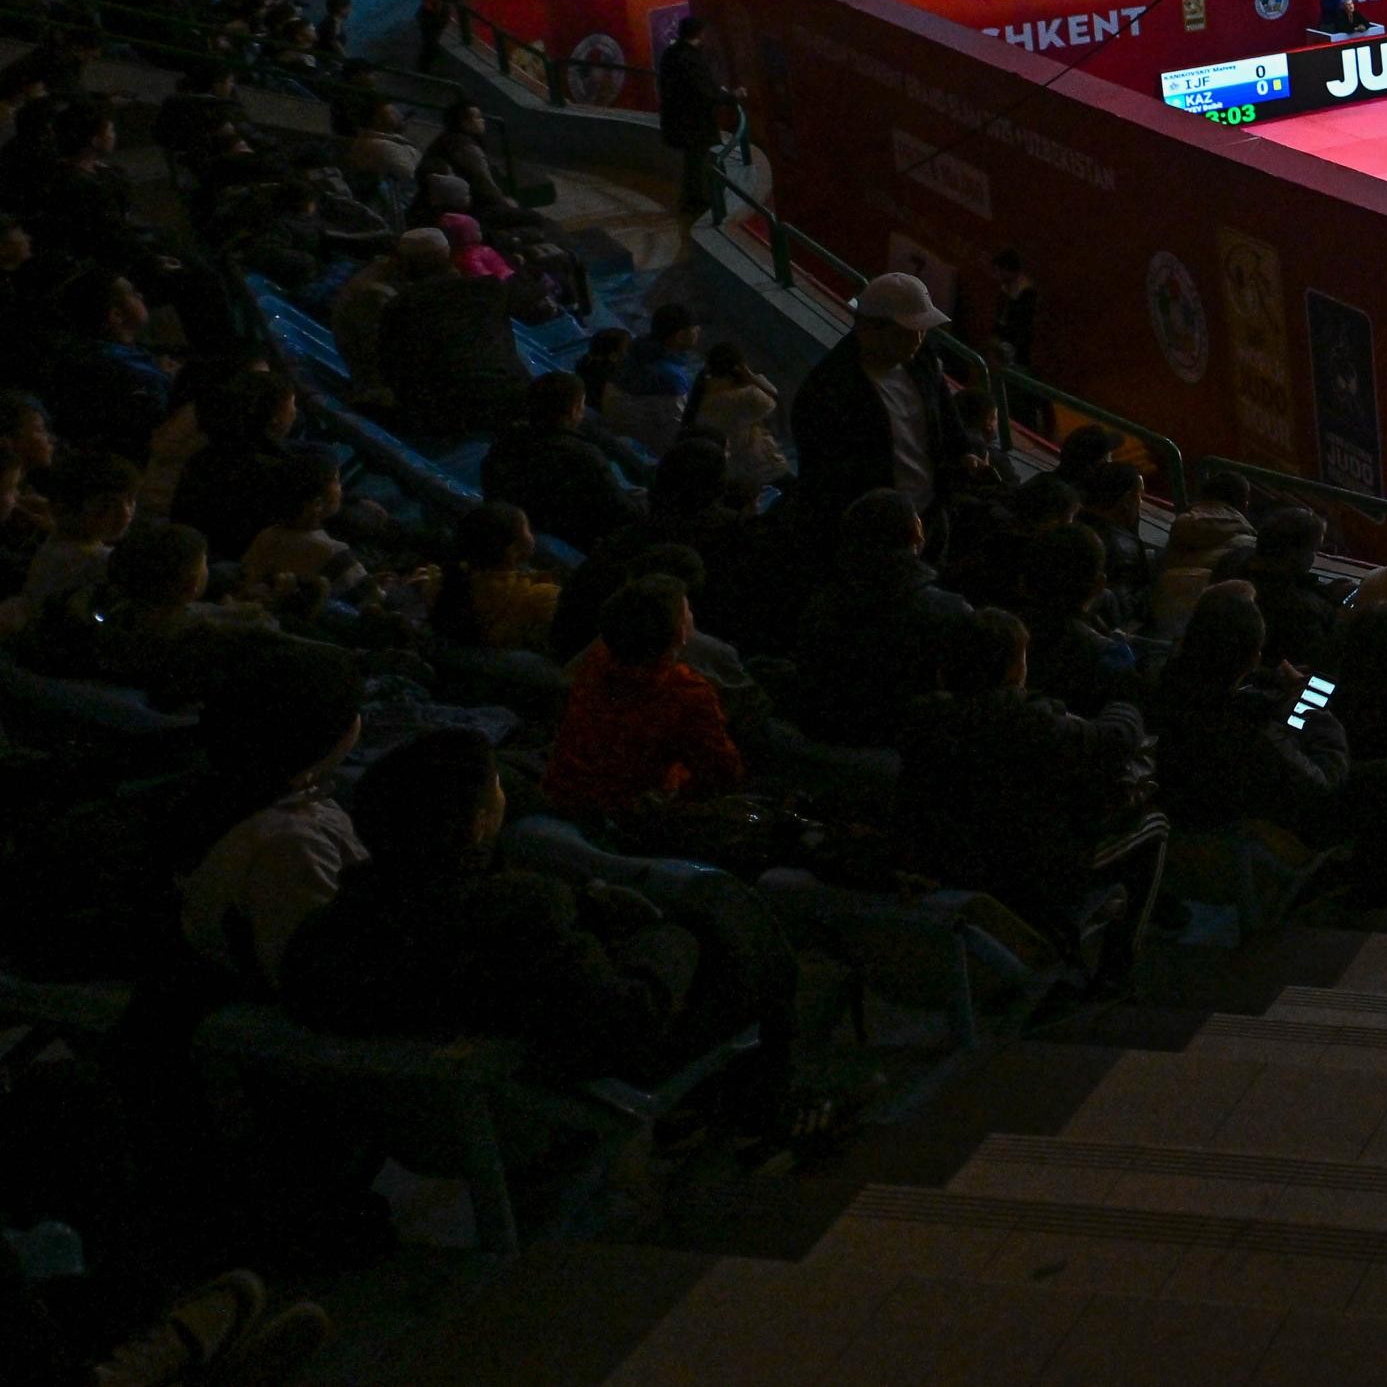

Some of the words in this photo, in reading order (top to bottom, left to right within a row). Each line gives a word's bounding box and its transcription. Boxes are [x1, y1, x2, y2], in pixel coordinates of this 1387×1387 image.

[1185, 76, 1210, 90] IJF
[1255, 65, 1266, 78] 0
[1185, 92, 1213, 107] KAZ
[1256, 80, 1269, 95] 0
